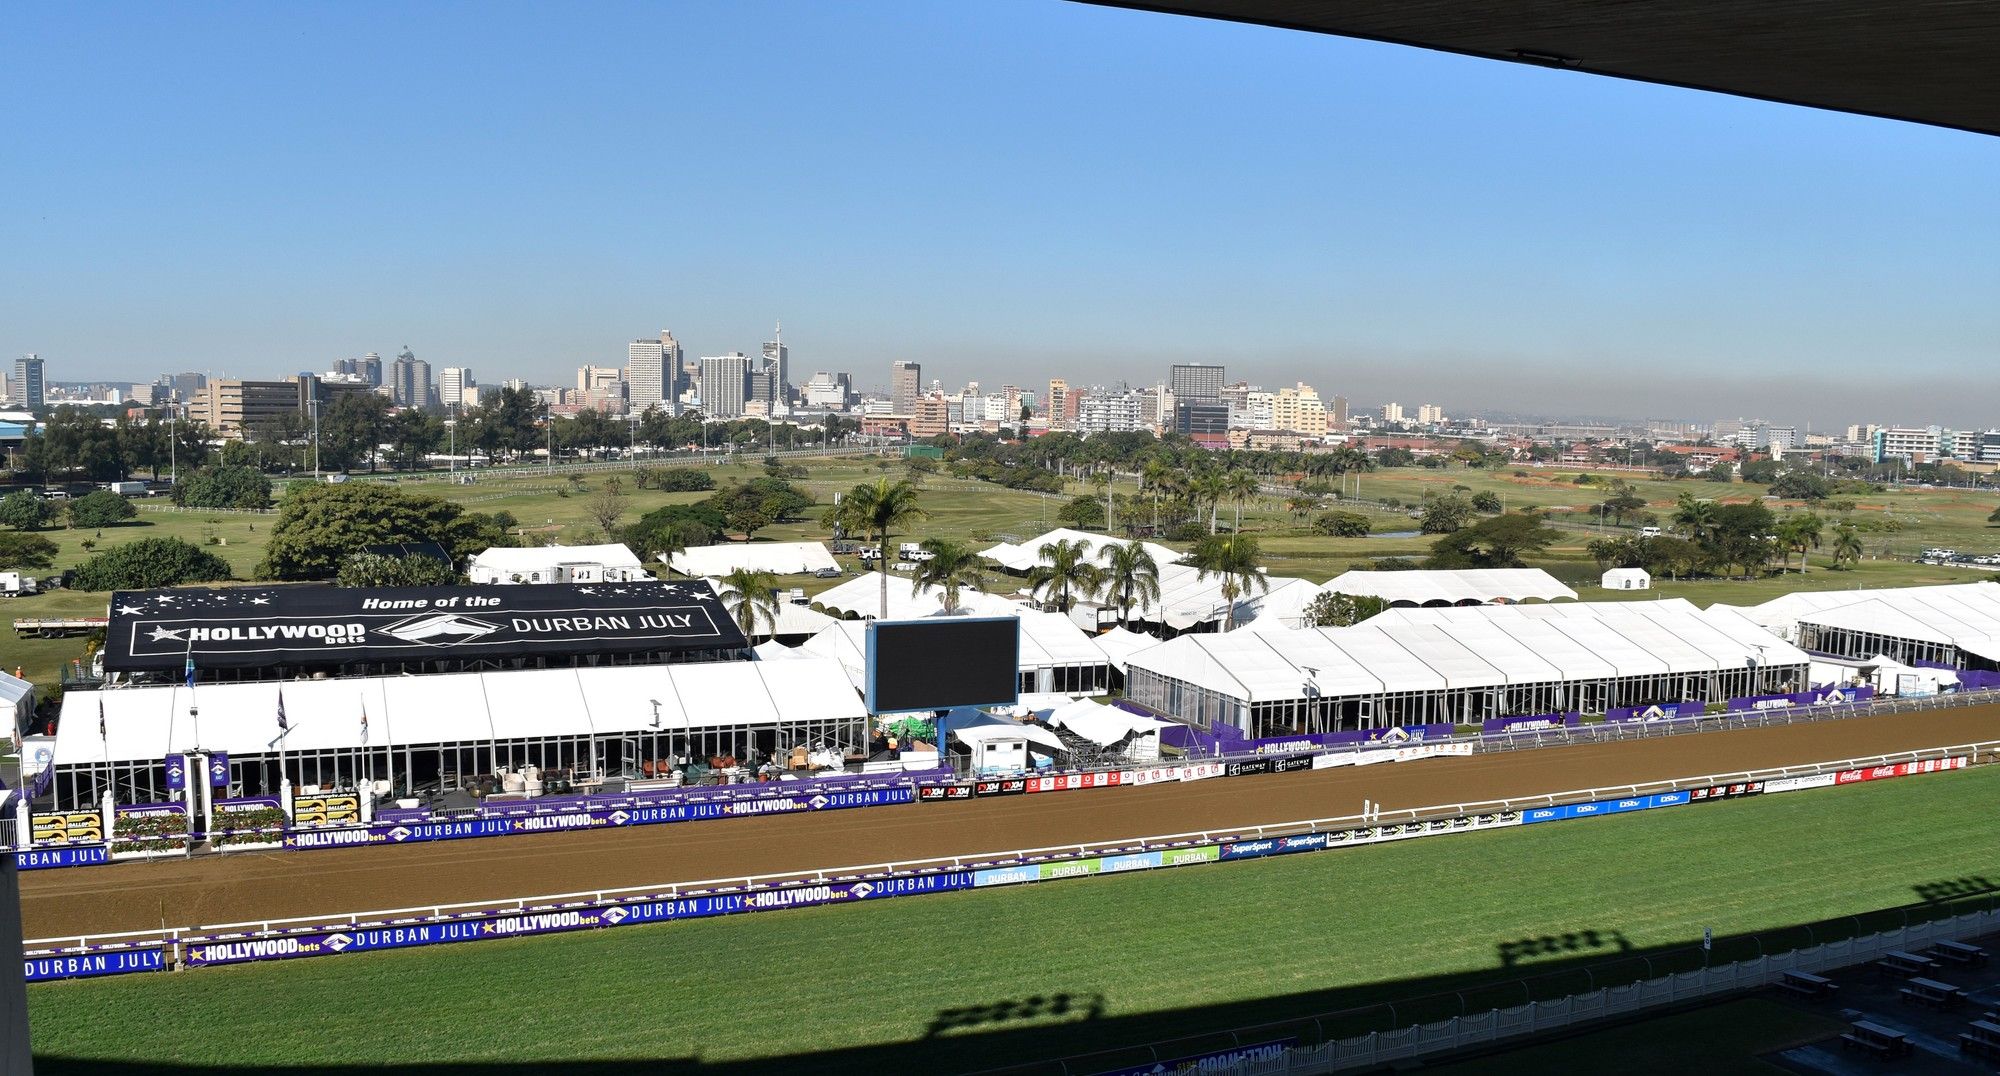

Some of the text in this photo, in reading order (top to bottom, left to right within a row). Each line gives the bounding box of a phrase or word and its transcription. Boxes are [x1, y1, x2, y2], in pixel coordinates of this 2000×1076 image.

[362, 595, 502, 610] Home of the
[511, 613, 693, 633] DURBAN JULY
[190, 623, 366, 642] HOLLYWOOD
[324, 635, 366, 645] bets
[414, 824, 472, 838] DURBAN
[480, 821, 512, 833] JULY
[632, 806, 684, 822] DURBAN
[692, 804, 721, 816] JULY
[830, 792, 879, 806] DURBAN
[885, 789, 912, 801] JULY
[1286, 836, 1326, 847] SuperSport
[1231, 842, 1272, 854] SuperSport
[18, 848, 106, 867] RBAN JULY
[1173, 852, 1208, 864] DURBAN
[1052, 864, 1089, 876] DURBAN
[1114, 858, 1150, 870] DURBAN
[988, 872, 1027, 883] DURBAN
[25, 956, 106, 977] DURBAN
[118, 951, 162, 969] JULY
[356, 928, 430, 946] DURBAN
[440, 922, 479, 939] JULY
[632, 900, 697, 918] DURBAN
[707, 896, 742, 911] JULY
[877, 876, 936, 893] DURBAN
[943, 871, 975, 887] JULY
